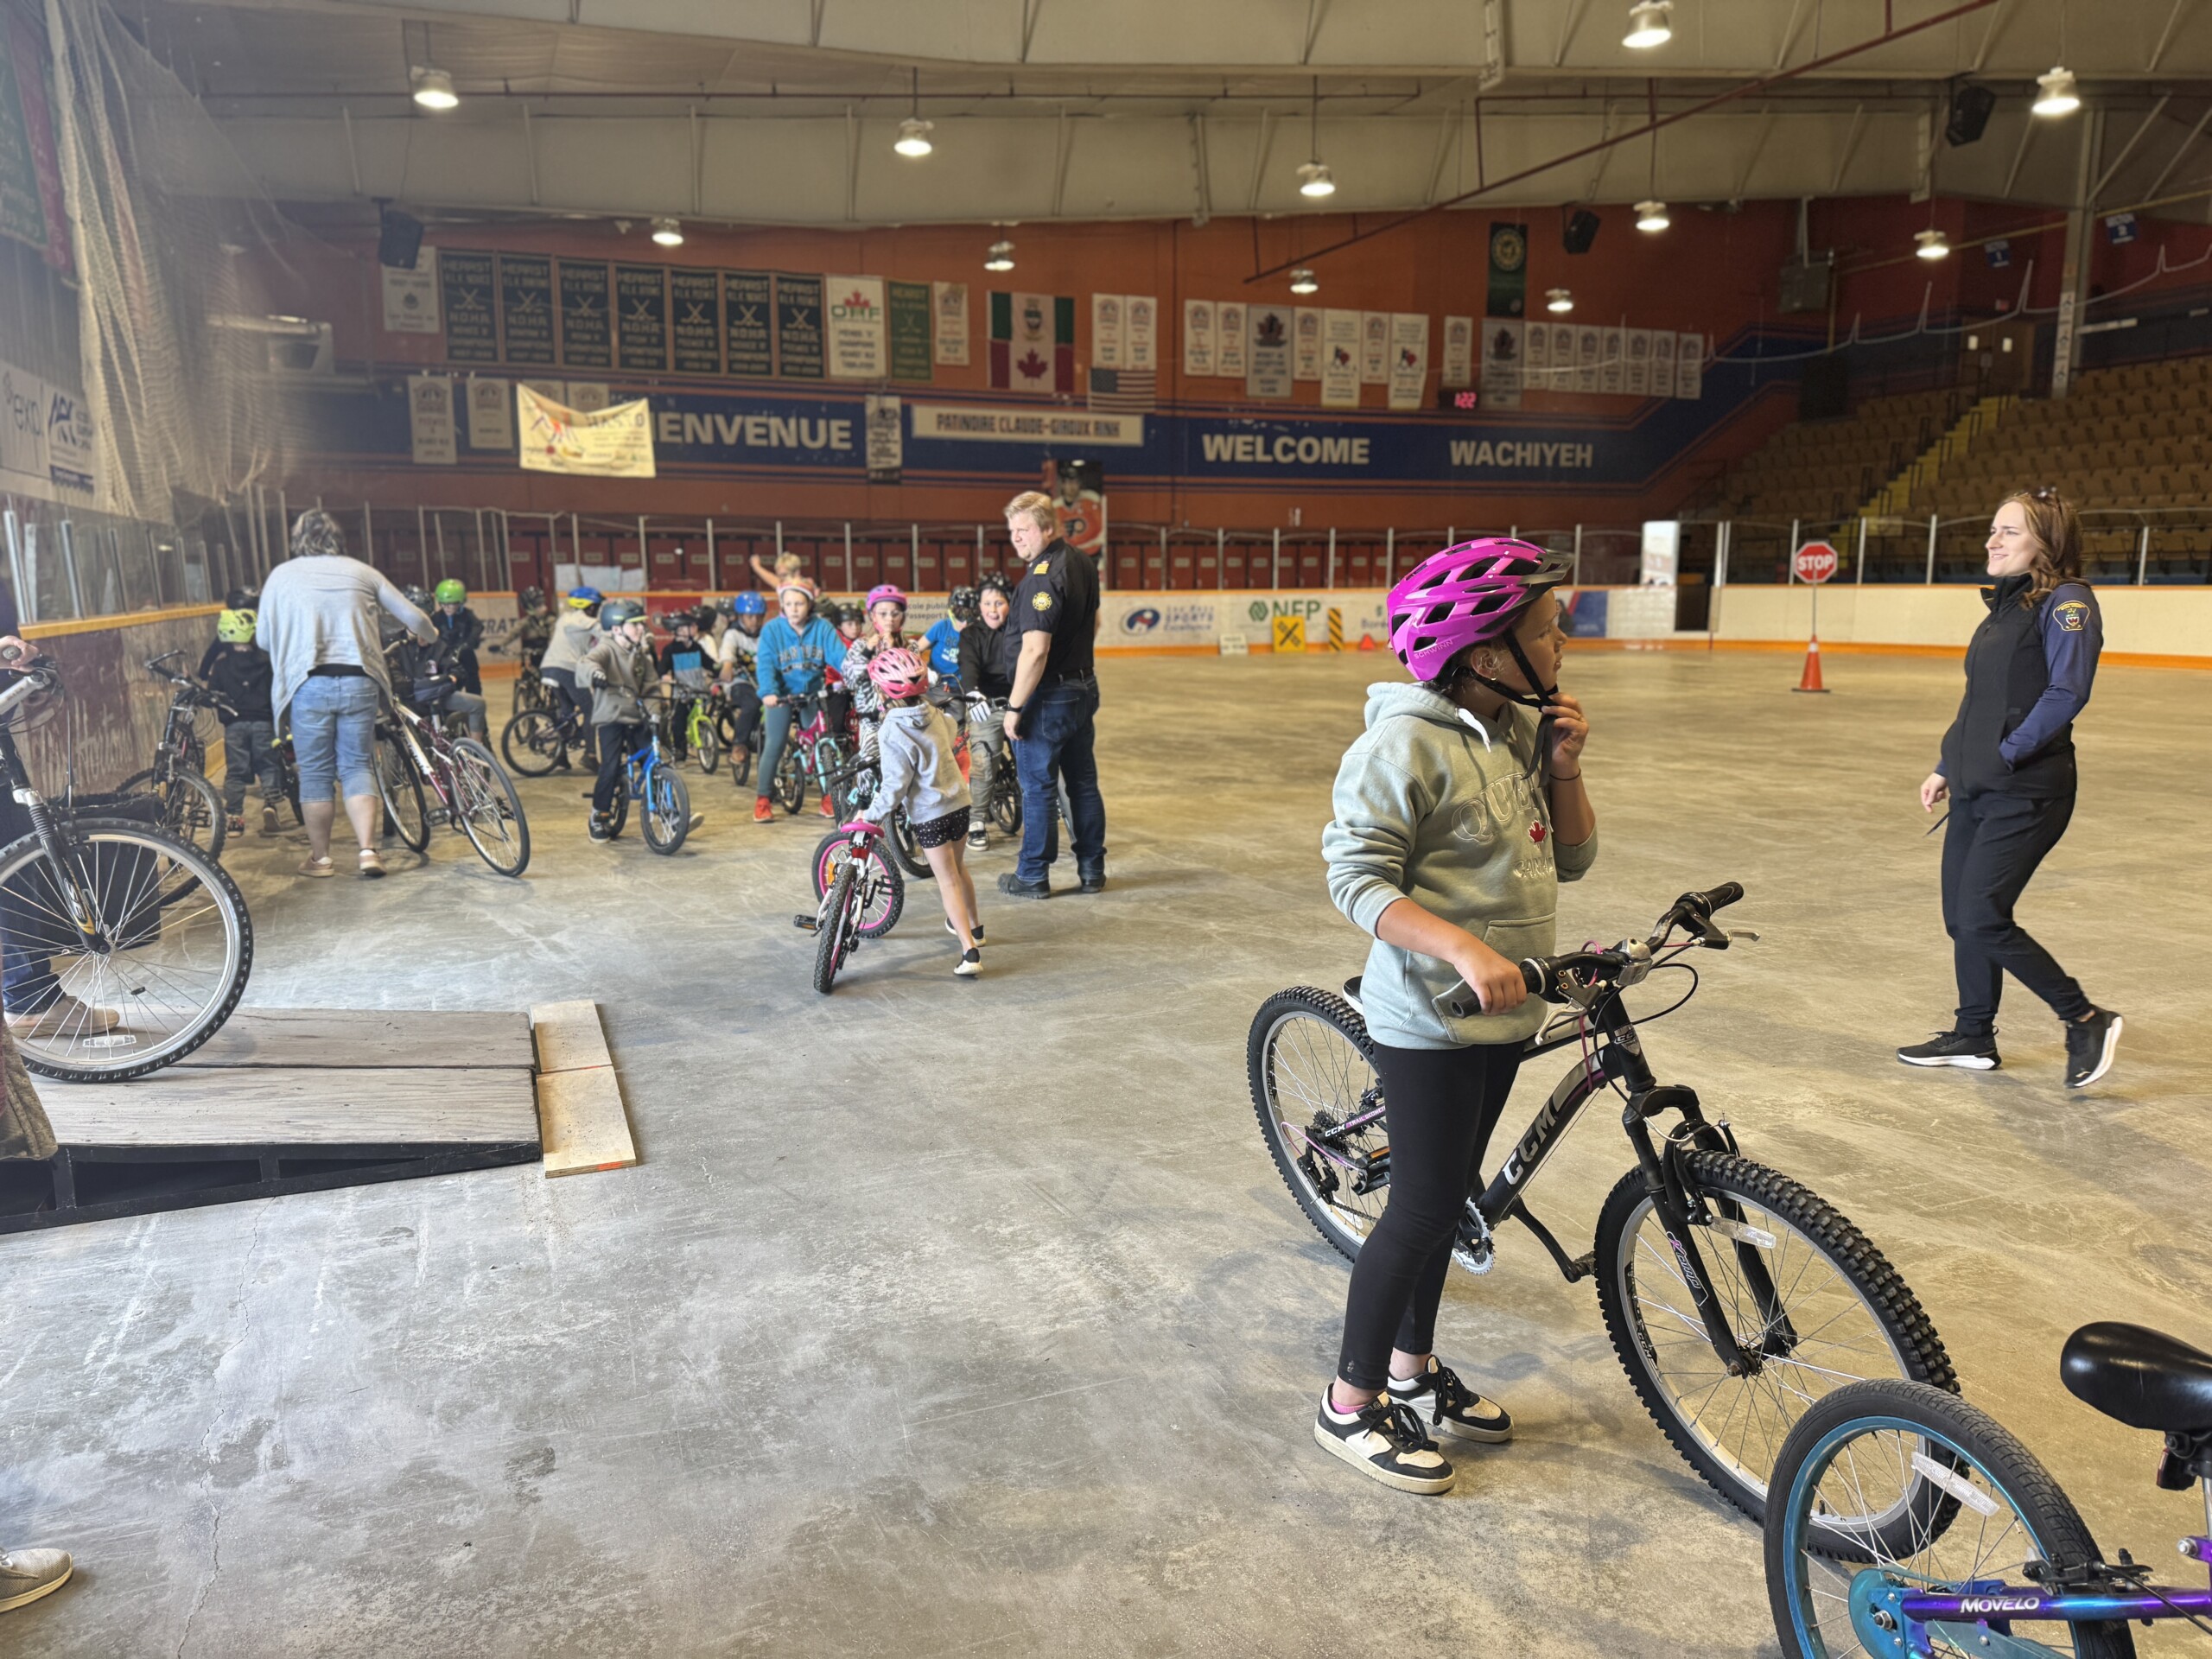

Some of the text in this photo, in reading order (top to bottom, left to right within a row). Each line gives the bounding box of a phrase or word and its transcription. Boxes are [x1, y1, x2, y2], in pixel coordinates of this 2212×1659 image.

[831, 305, 880, 319] OHF
[650, 411, 853, 450] IENVENUE
[1093, 421, 1121, 438] RINK
[1202, 435, 1370, 464] WELCOME
[1450, 440, 1593, 467] WACHIYEH
[1797, 554, 1834, 571] STOP
[1272, 600, 1321, 620] NFP
[1414, 639, 1453, 659] SCHWINN
[1325, 1123, 1346, 1137] CCM
[1348, 1116, 1366, 1127] TRAIL
[1502, 1100, 1556, 1185] CCM
[1960, 1597, 2040, 1613] MOVELO
